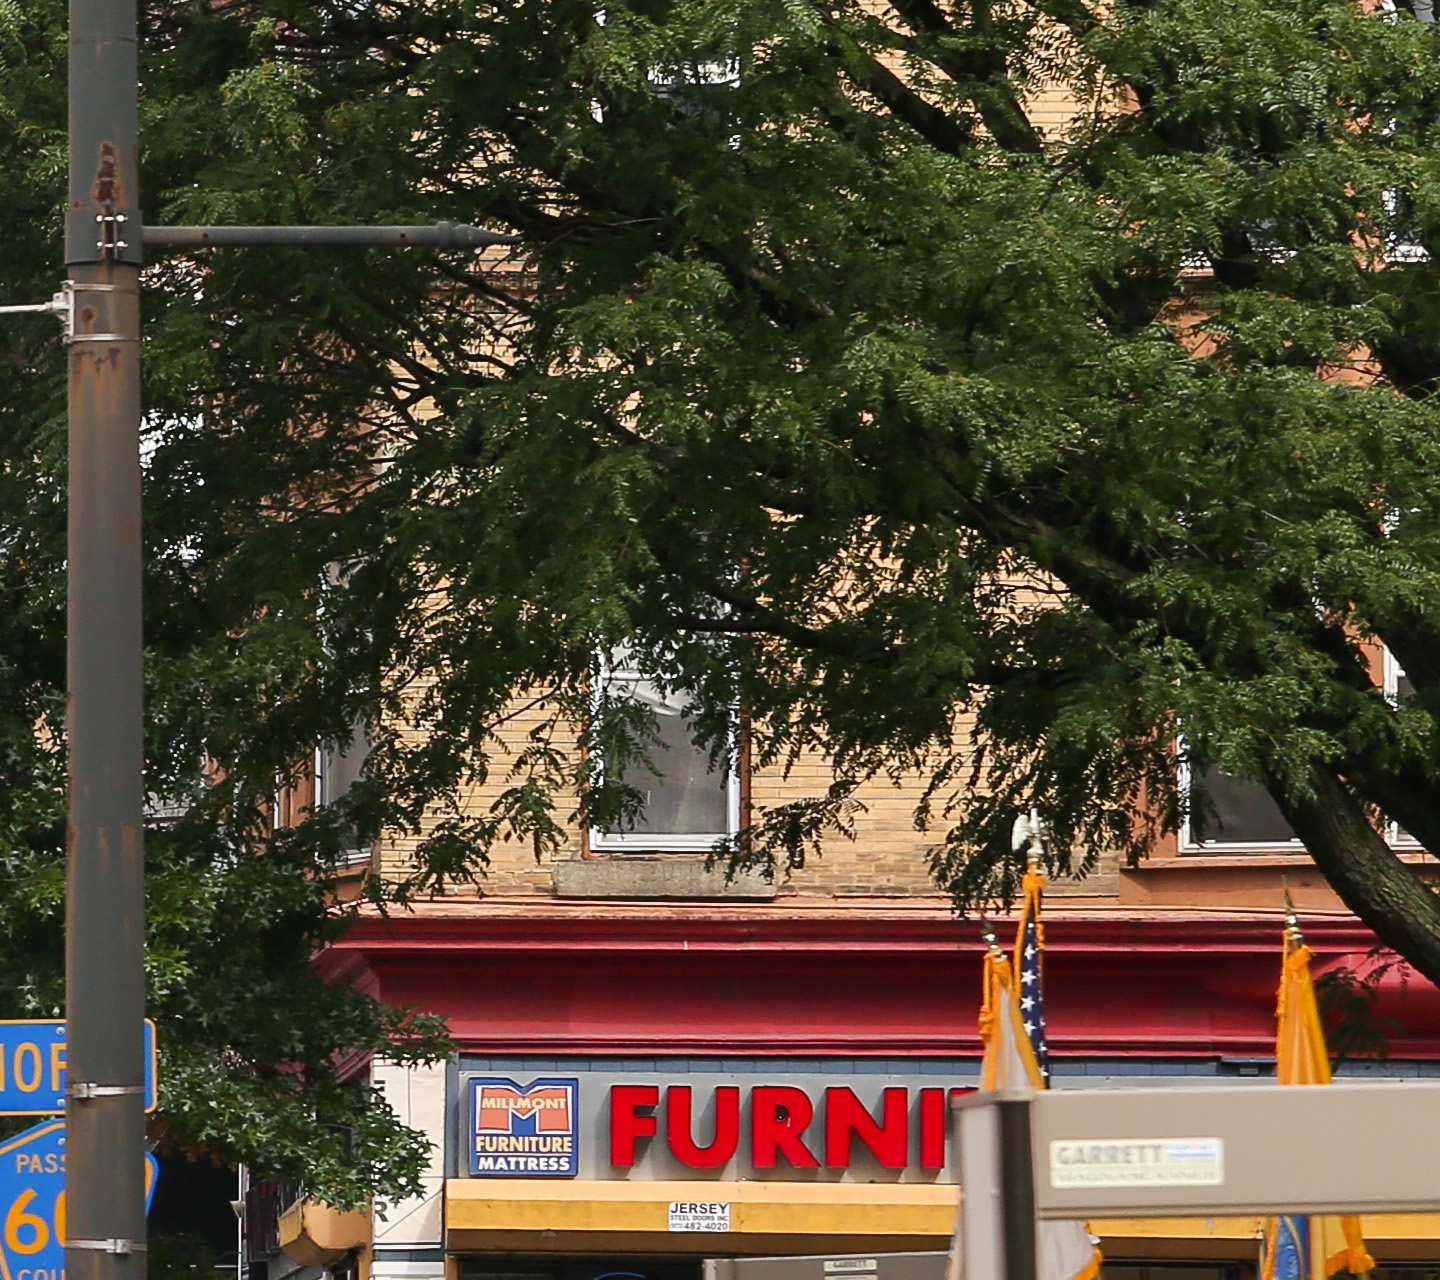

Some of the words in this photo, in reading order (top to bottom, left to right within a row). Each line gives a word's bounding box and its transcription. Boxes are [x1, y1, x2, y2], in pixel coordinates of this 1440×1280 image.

[481, 1096, 568, 1110] MILLMONT
[610, 1085, 978, 1168] FURNI
[476, 1136, 573, 1153] FURNITURE
[1056, 1145, 1162, 1165] GARRETT
[478, 1157, 571, 1171] MATTRESS
[670, 1203, 728, 1214] JERSEY
